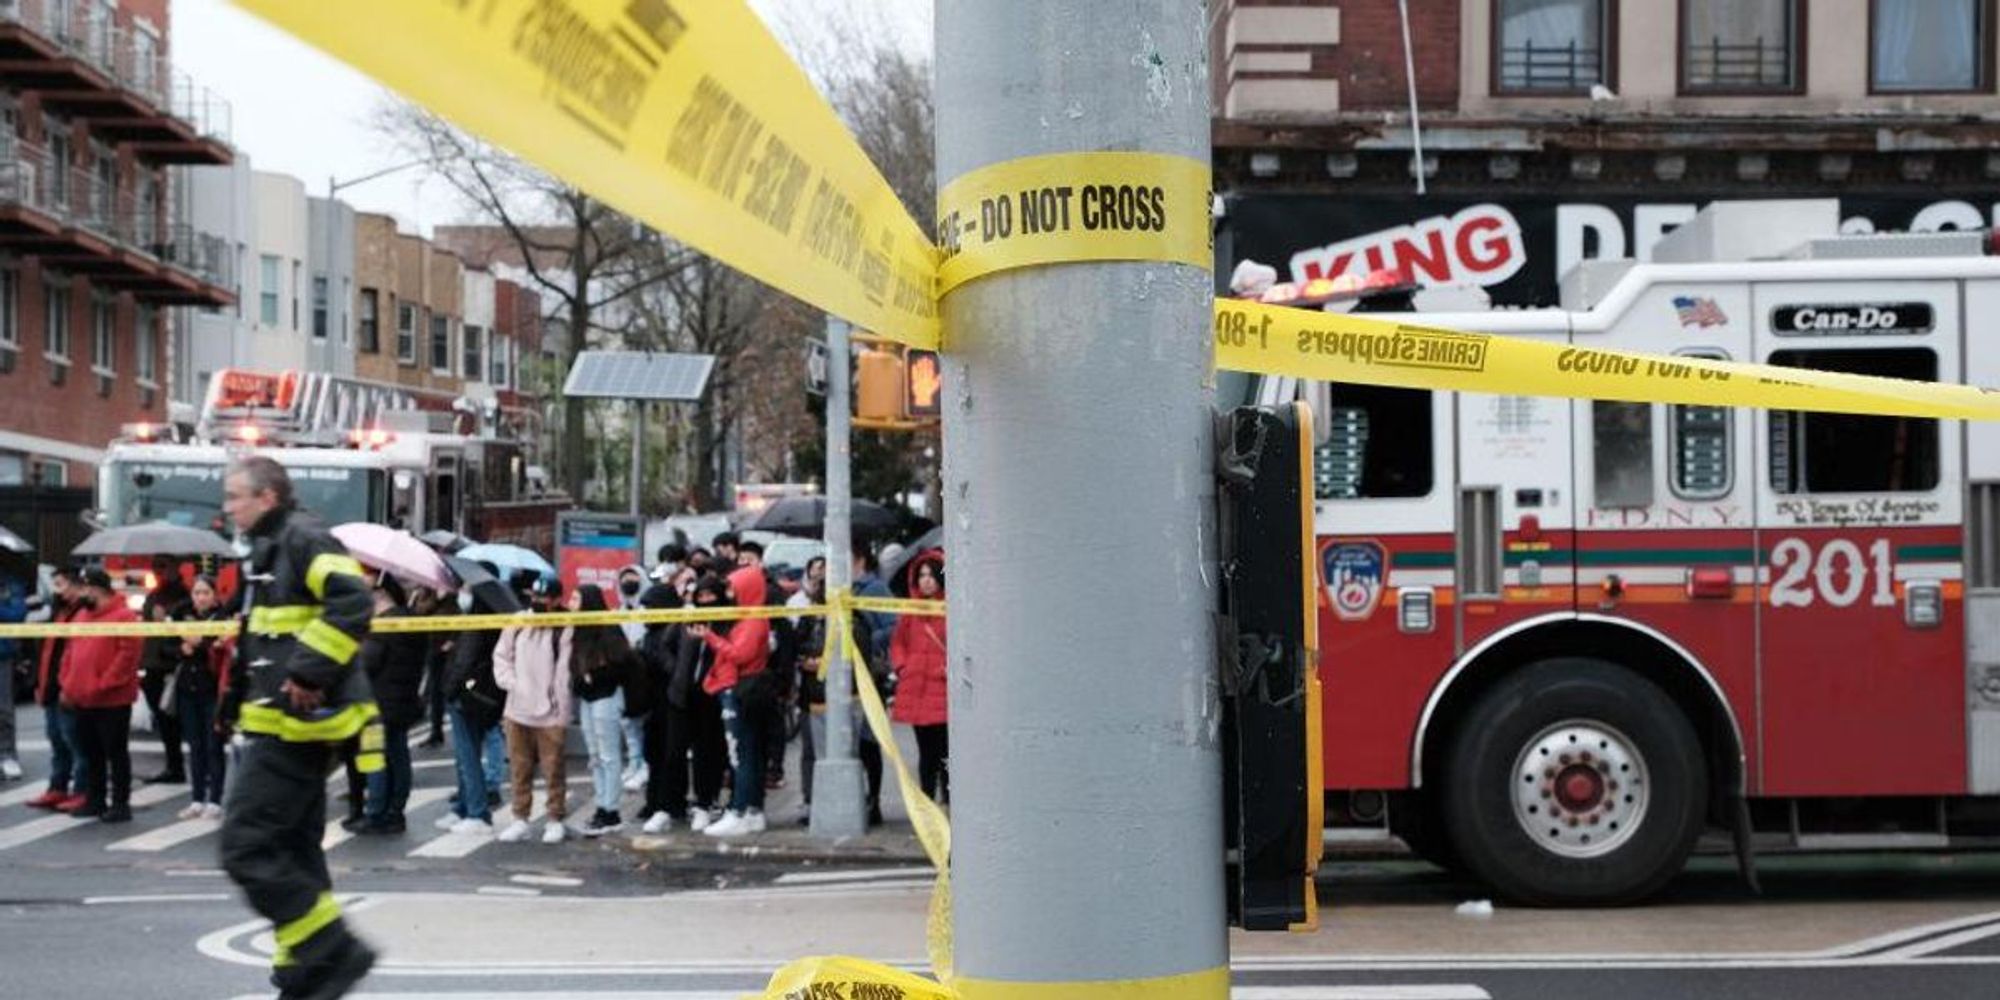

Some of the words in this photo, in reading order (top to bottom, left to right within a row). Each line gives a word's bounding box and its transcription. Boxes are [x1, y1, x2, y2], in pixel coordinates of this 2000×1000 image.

[981, 197, 1012, 242] DO
[1020, 187, 1073, 234] NOT
[1081, 186, 1165, 232] CROSS
[1794, 309, 1898, 330] Can-Do
[1769, 538, 1896, 608] 201
